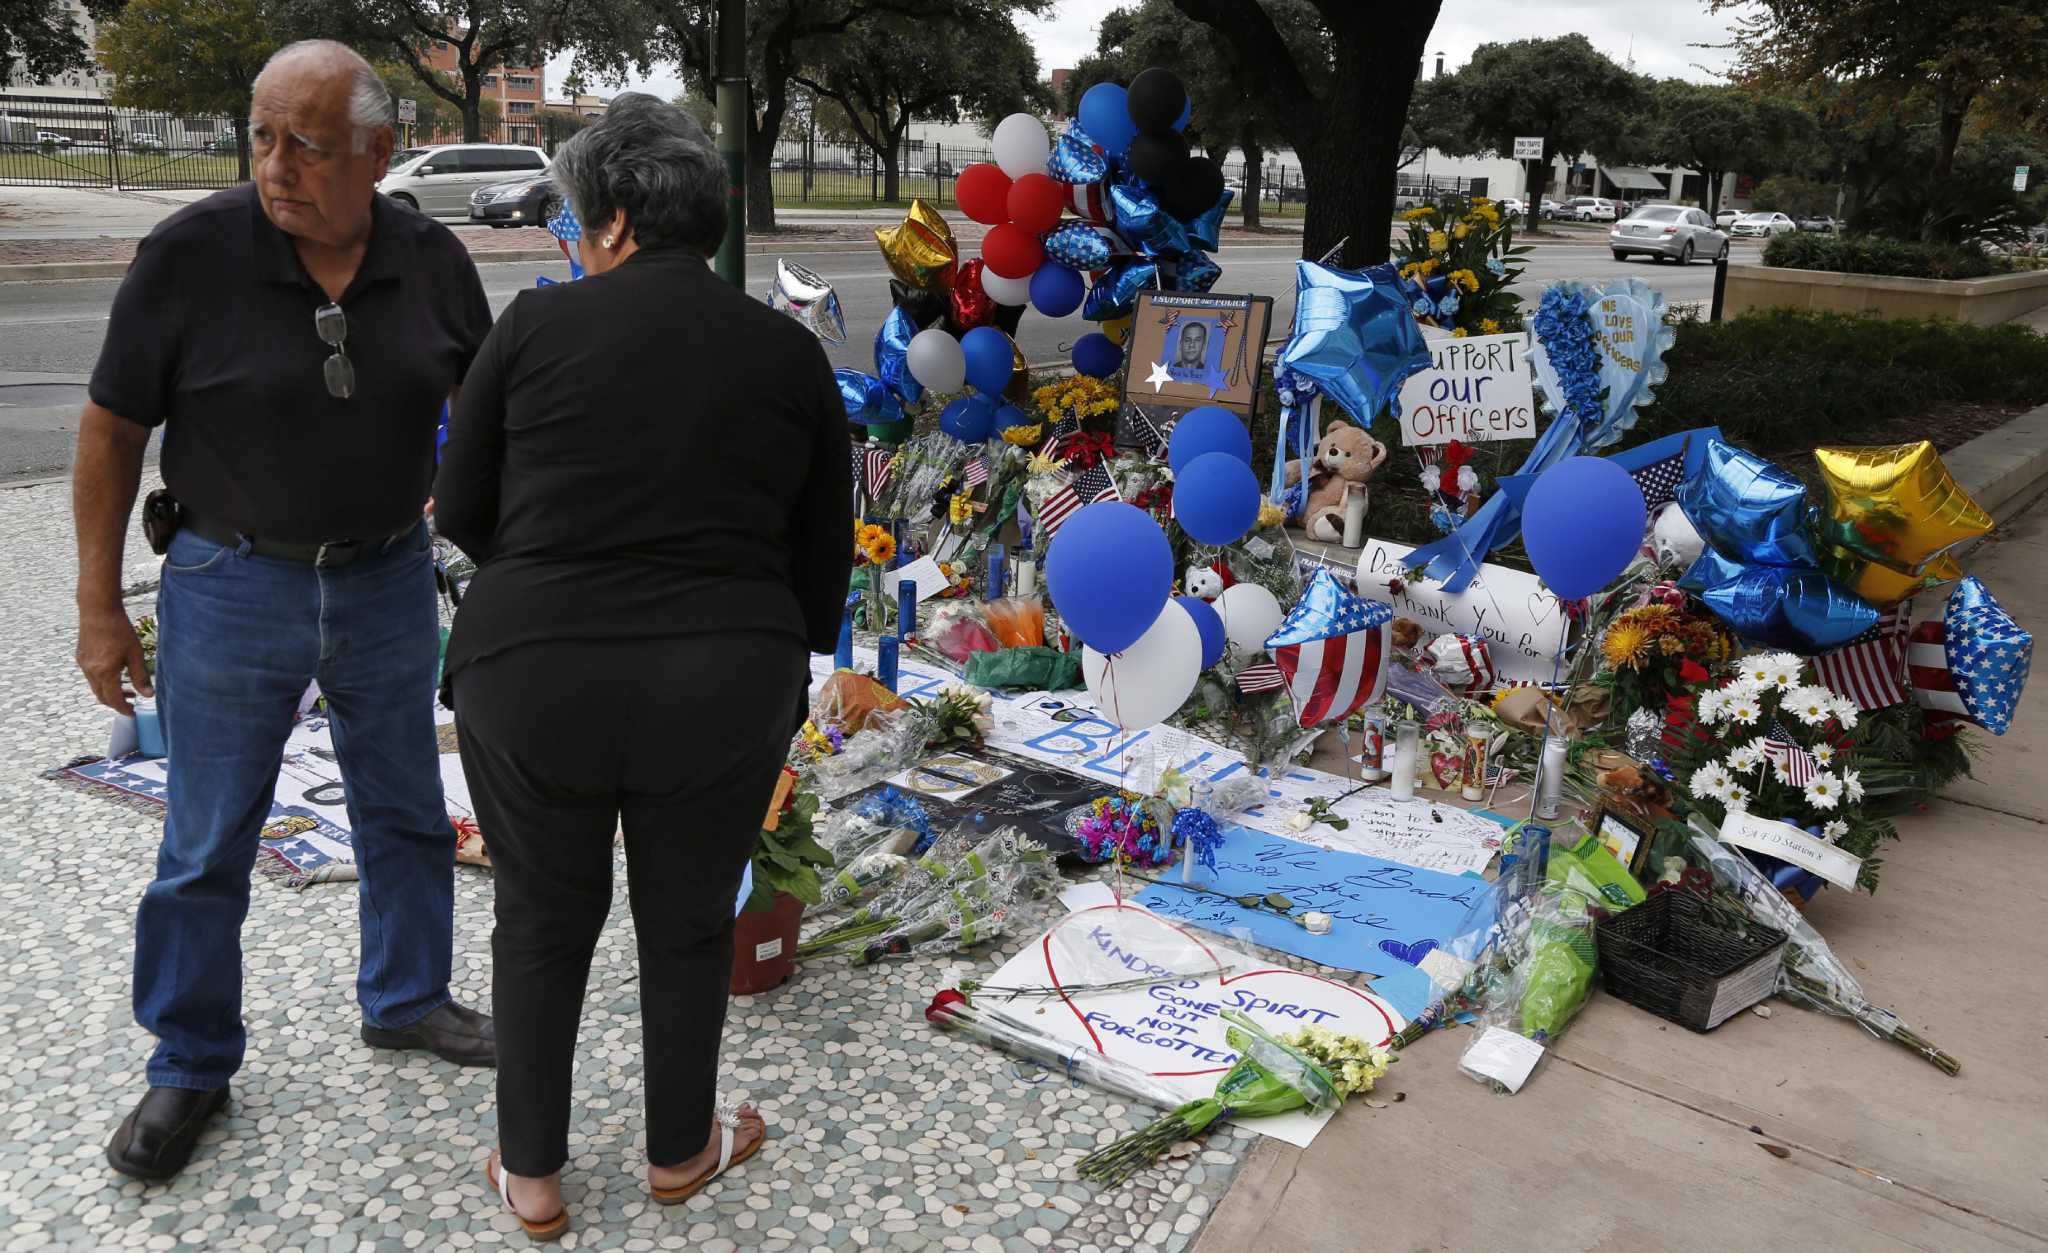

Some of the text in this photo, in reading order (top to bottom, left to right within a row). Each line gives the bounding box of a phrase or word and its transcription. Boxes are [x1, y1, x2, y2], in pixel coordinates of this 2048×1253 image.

[1156, 296, 1200, 305] SUPPORT
[1215, 299, 1248, 307] POLICE
[1604, 314, 1633, 328] LOVE
[1612, 331, 1633, 343] OUR
[1412, 404, 1529, 437] Officers
[1344, 867, 1473, 908] Back
[1086, 924, 1340, 1024] KINDRED SPIRIT
[1147, 985, 1222, 1015] GONE
[1156, 1003, 1209, 1023] BUT
[1084, 1010, 1240, 1064] FORGOTTEN
[1136, 1015, 1198, 1037] NOT
